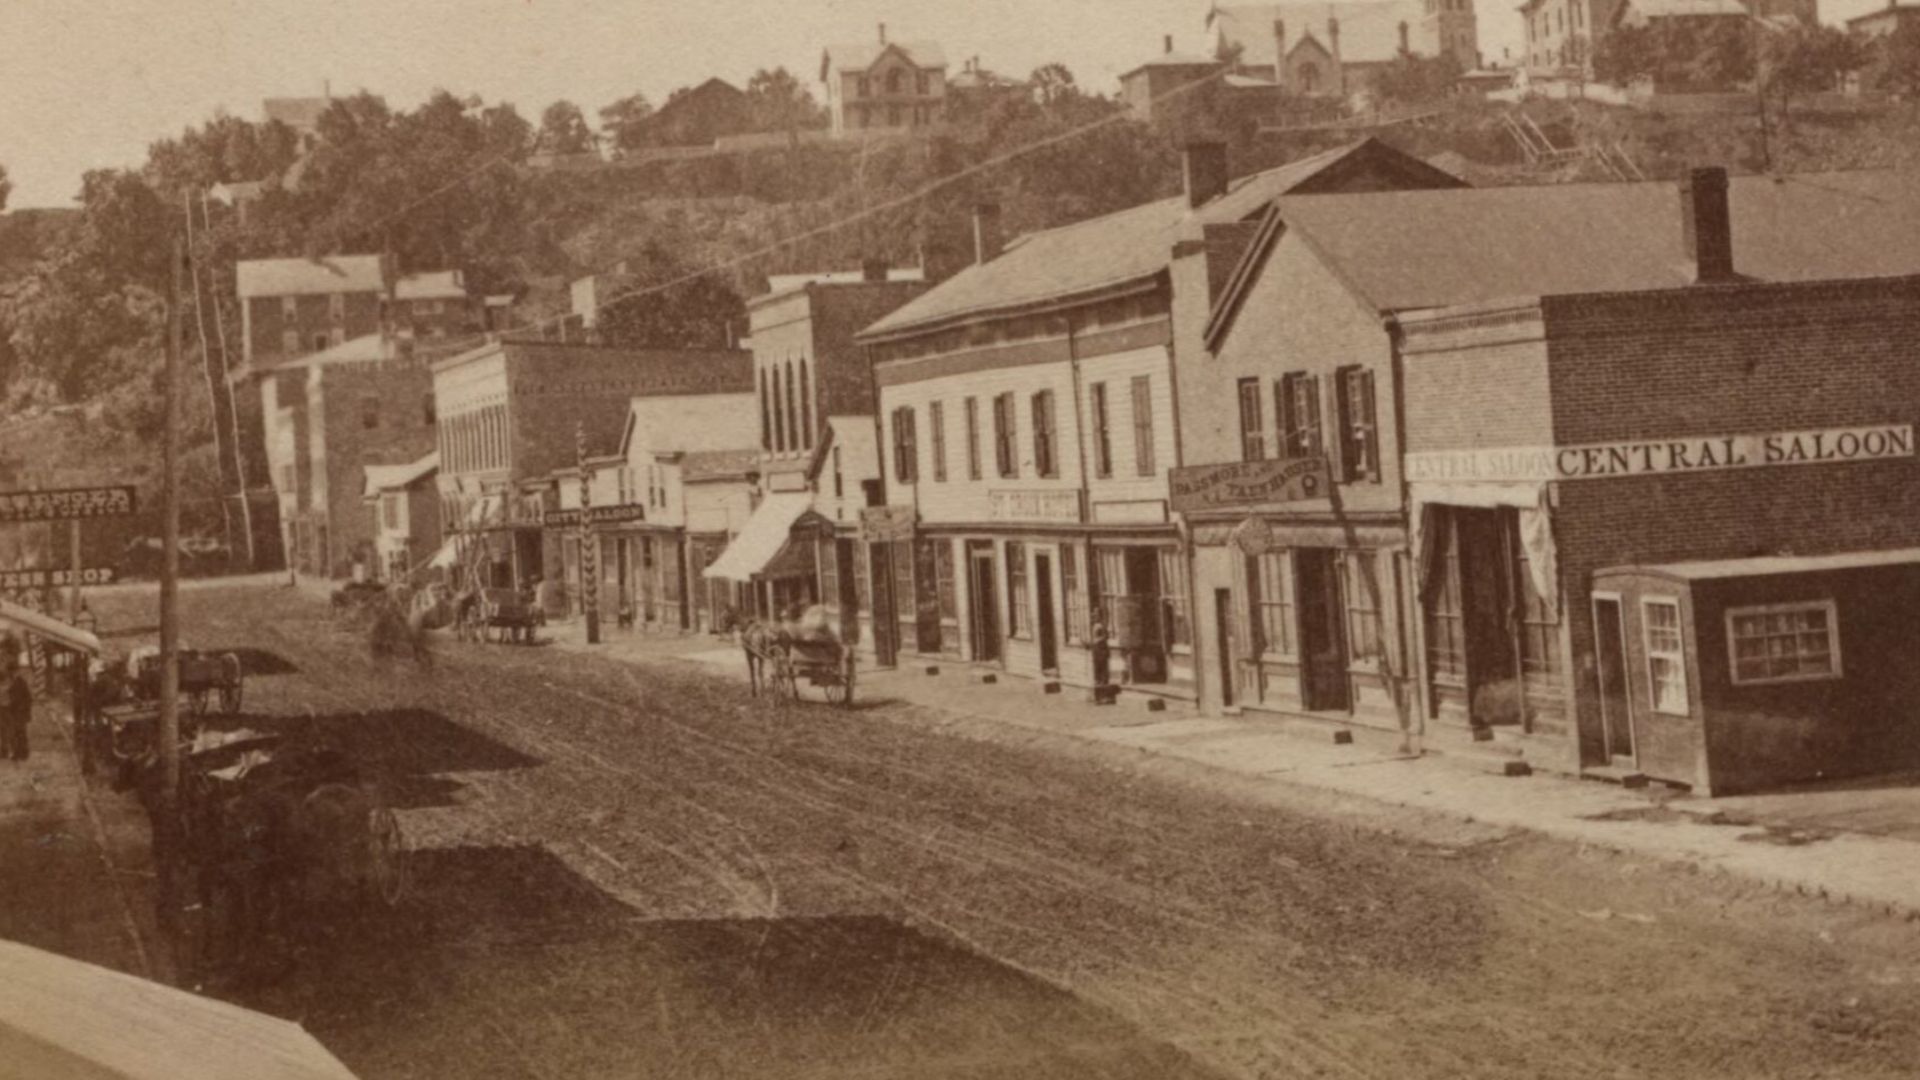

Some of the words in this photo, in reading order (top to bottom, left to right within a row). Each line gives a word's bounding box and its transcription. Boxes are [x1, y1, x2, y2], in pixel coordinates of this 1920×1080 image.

[1556, 437, 1746, 477] CENTRAL
[1762, 427, 1910, 463] SALOON
[592, 507, 641, 521] ALOON
